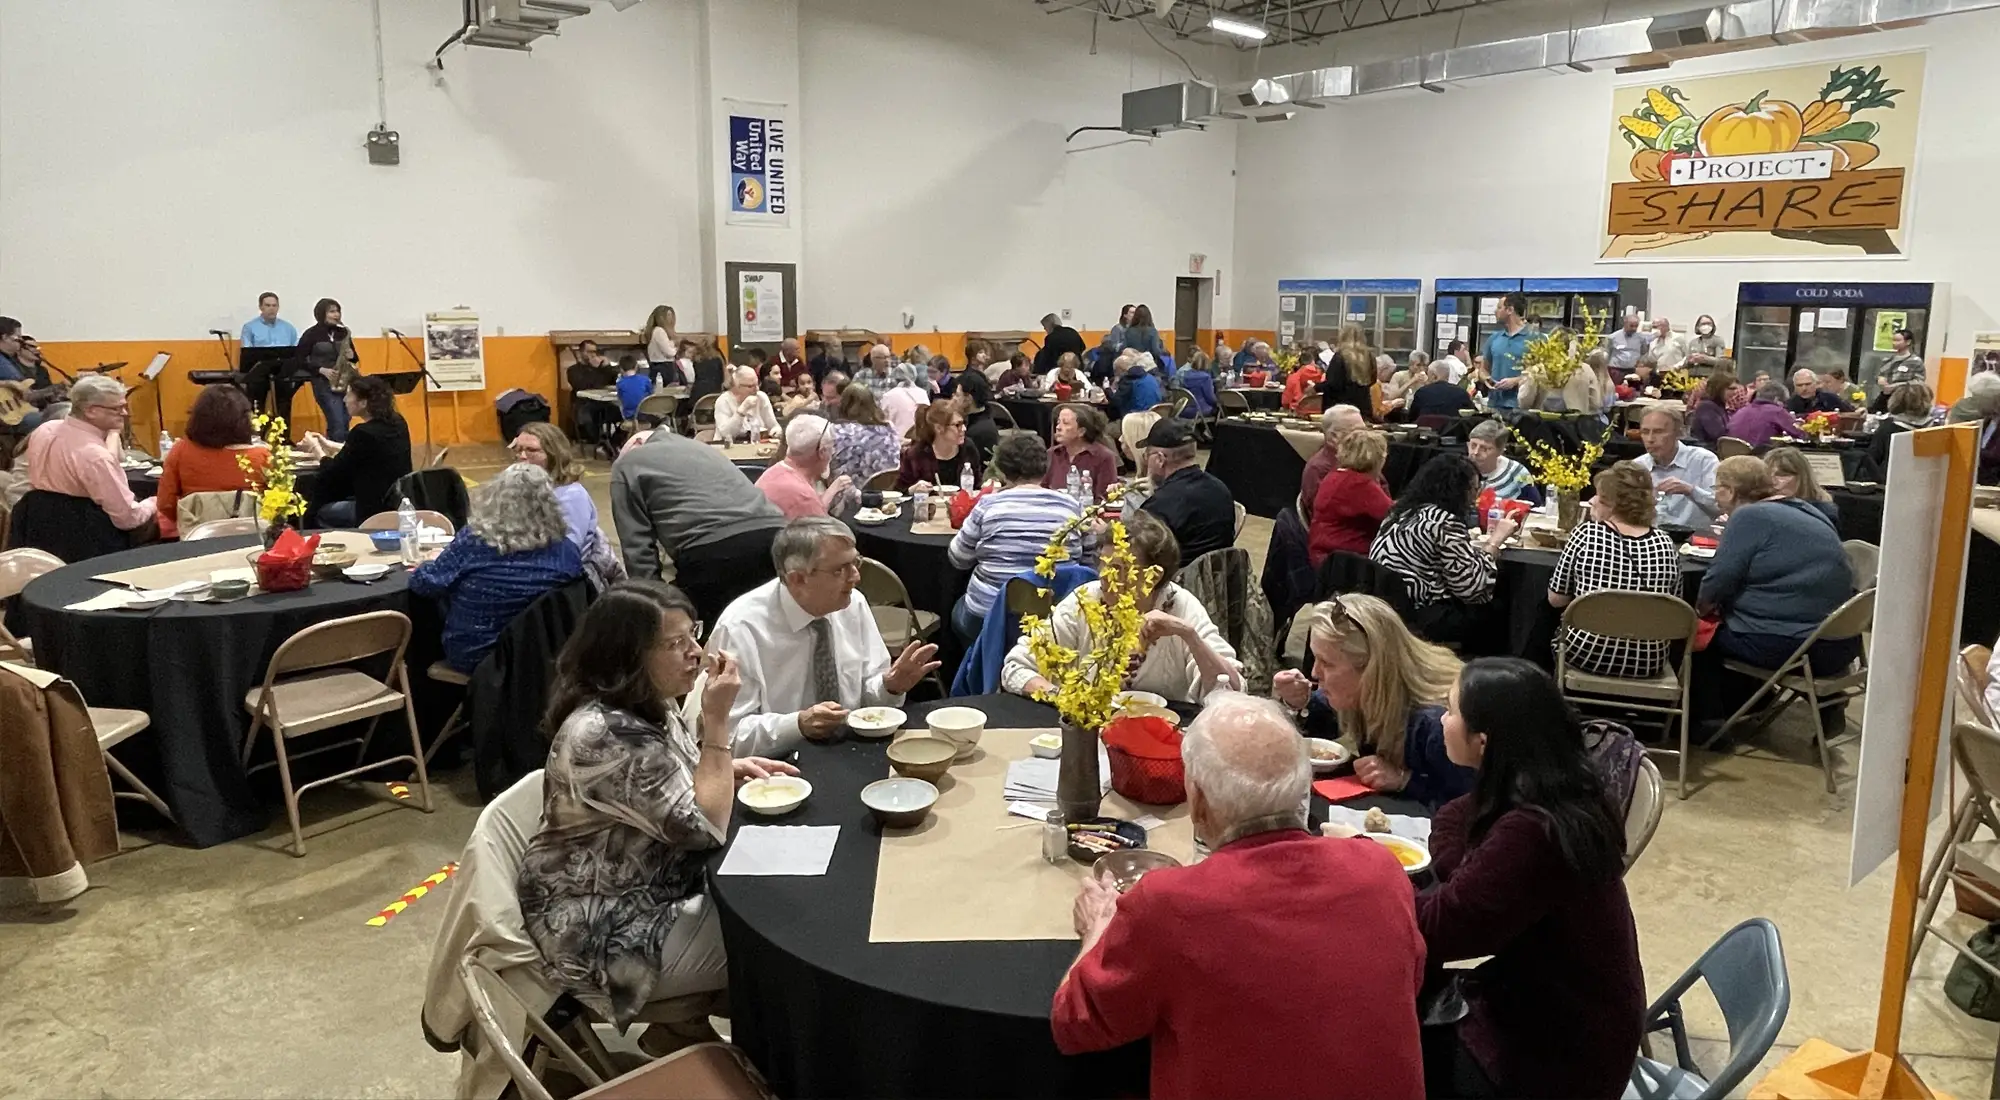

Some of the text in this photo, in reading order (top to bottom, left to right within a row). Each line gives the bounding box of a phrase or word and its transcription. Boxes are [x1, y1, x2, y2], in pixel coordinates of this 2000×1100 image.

[733, 139, 747, 171] Way
[748, 119, 763, 172] United
[769, 120, 786, 215] LIVE UNITED
[1688, 157, 1814, 180] PROJECT
[1642, 181, 1876, 228] SHARE
[1795, 288, 1864, 297] COLD SODA
